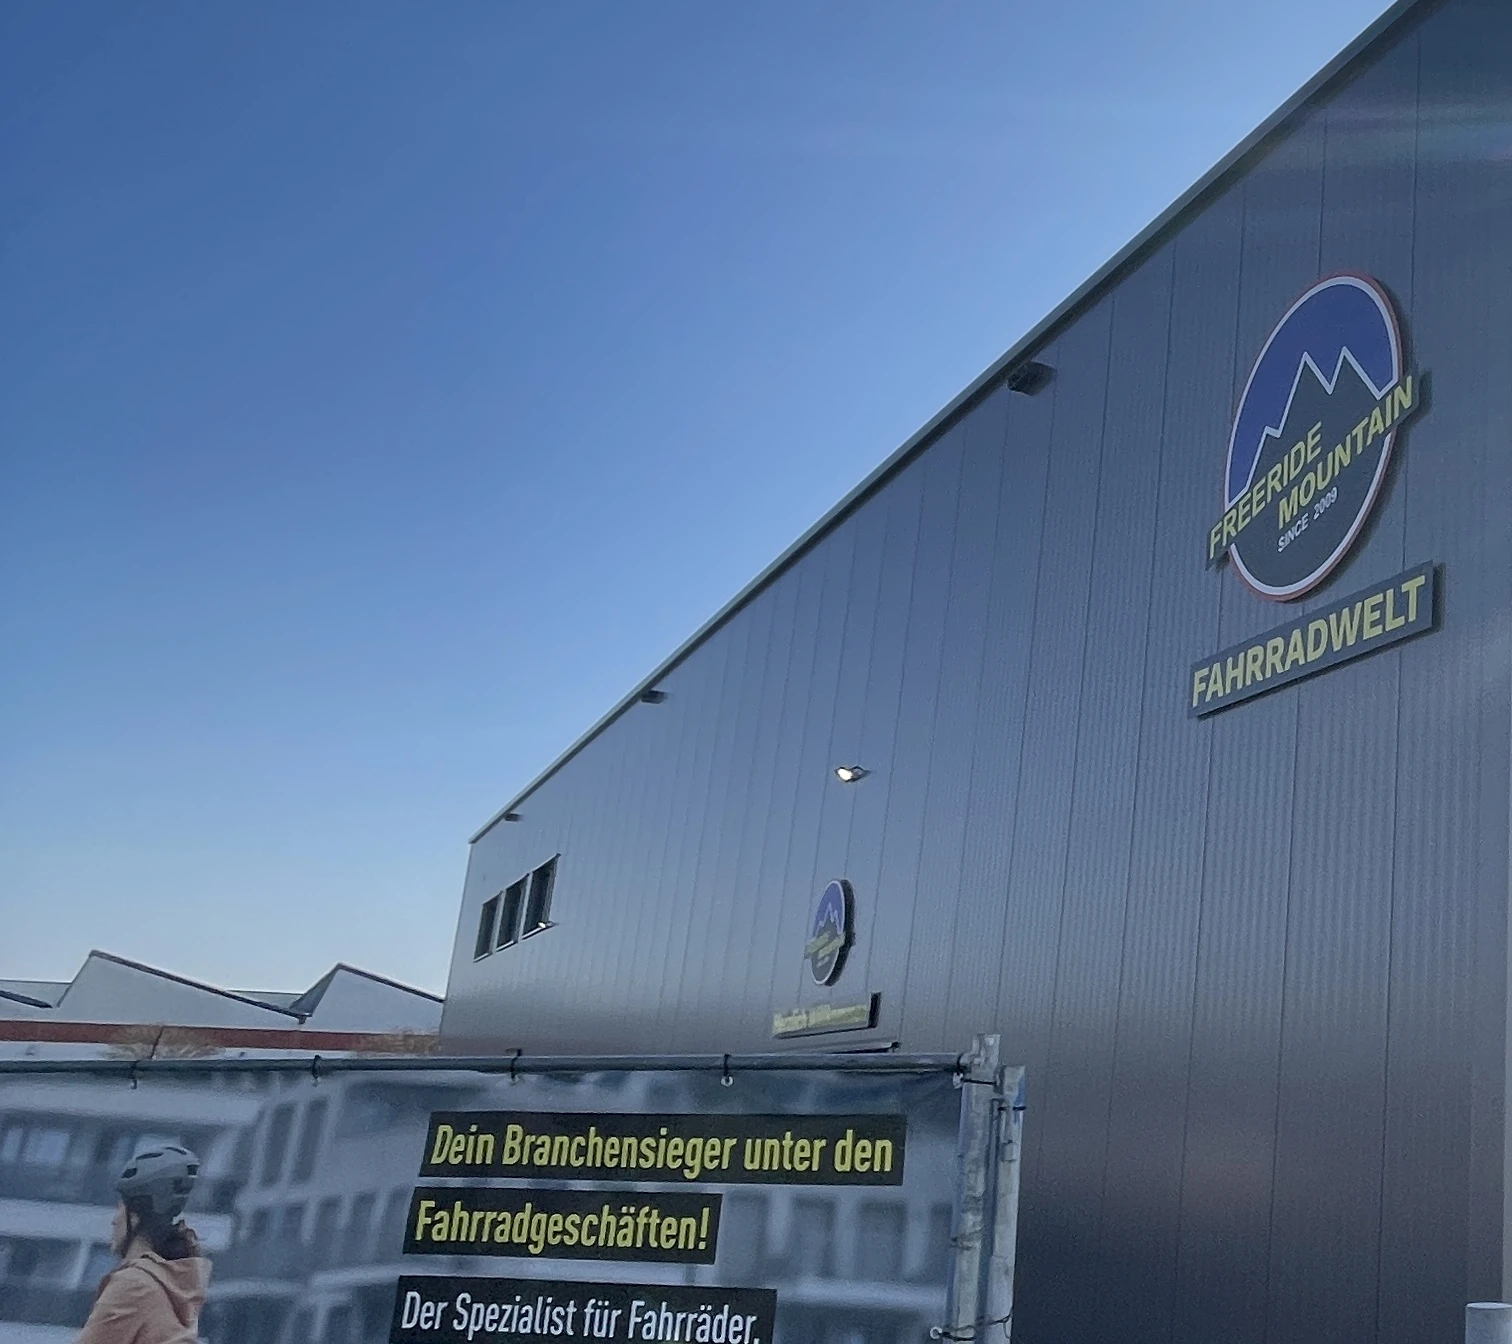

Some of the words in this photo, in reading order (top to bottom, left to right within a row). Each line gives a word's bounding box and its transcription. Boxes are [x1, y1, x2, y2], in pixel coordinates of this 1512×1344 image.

[1278, 375, 1415, 530] MOUNTAIN
[1209, 421, 1323, 560] FREERIDE
[1277, 513, 1309, 553] SINCE
[1313, 486, 1338, 521] 2009
[1192, 574, 1426, 709] FAHRRADWELT
[429, 1123, 496, 1167] Dein
[502, 1124, 737, 1181] Branchensieger
[743, 1130, 825, 1172] unter
[833, 1129, 893, 1173] den
[414, 1200, 711, 1254] Fahrradgeschäften!
[400, 1290, 444, 1331] Der
[451, 1293, 577, 1341] Spezialist
[583, 1299, 622, 1339] für
